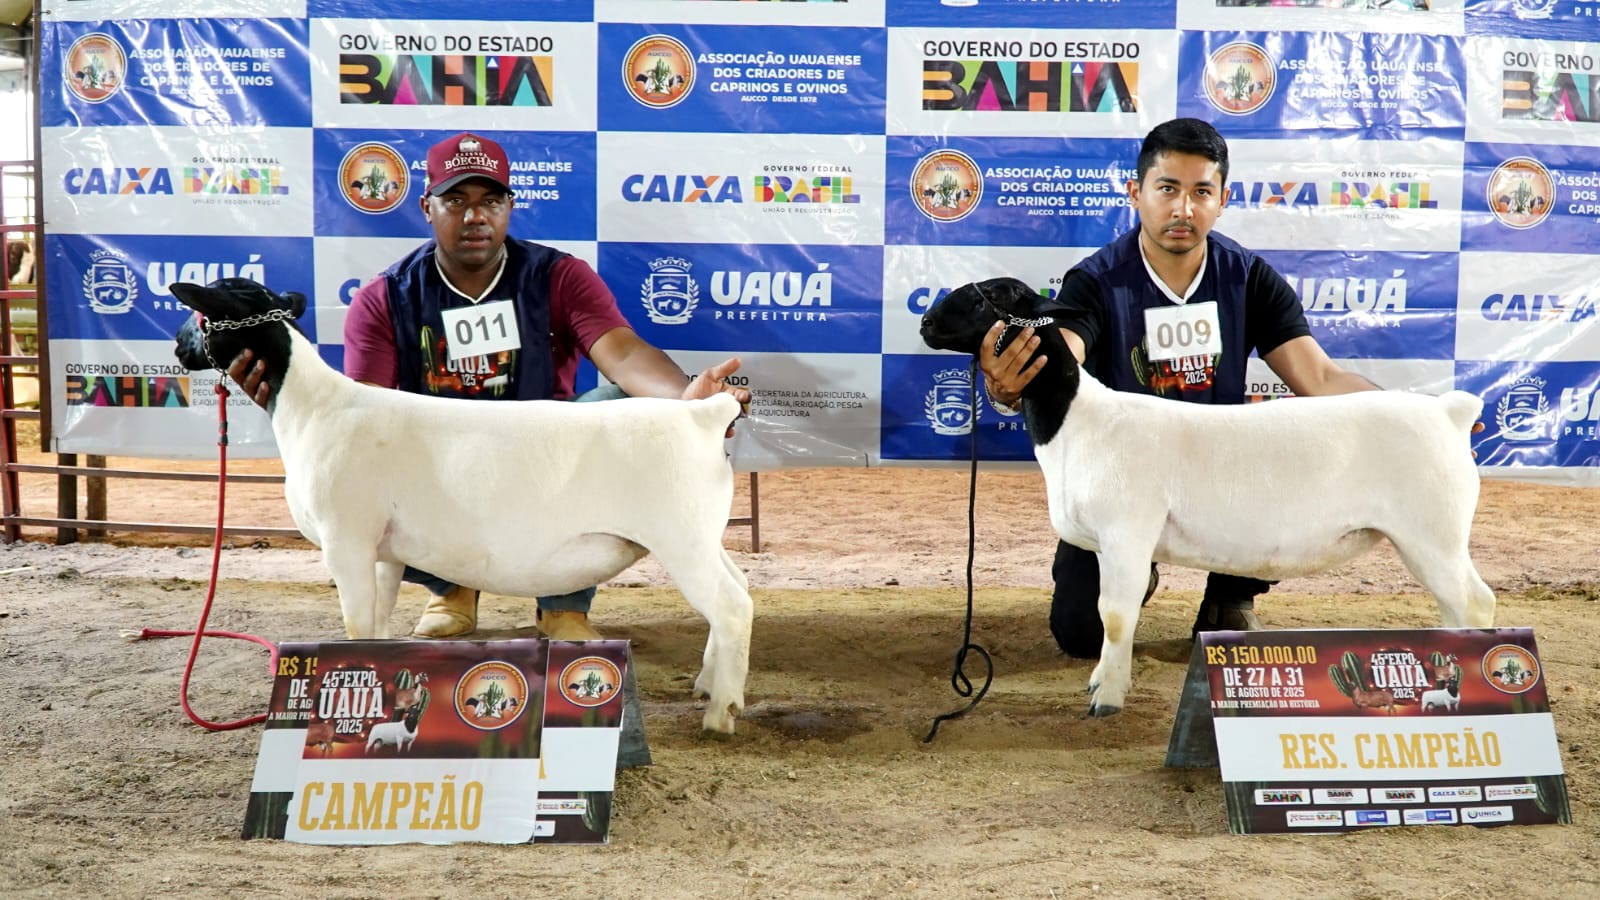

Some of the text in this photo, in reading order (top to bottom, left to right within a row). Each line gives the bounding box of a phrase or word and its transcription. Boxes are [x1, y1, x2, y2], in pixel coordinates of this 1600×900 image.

[339, 34, 553, 52] GOVERNO DO ESTADO
[923, 40, 1140, 59] GOVERNO DO ESTADO
[698, 51, 862, 67] ASSOCIAÇÃO UAUAENSE
[252, 62, 270, 72] DE
[713, 67, 845, 80] DOS CRIADORES DE
[210, 76, 218, 86] E
[339, 54, 553, 106] BAHIA
[922, 60, 1139, 112] BAHIA
[710, 82, 848, 94] CAPRINOS E OVINOS
[741, 95, 768, 103] AUCCO
[444, 156, 499, 170] BOECHAT
[538, 175, 557, 186] DE
[985, 165, 1139, 181] ASSOCIAÇÃO UAUAENS
[63, 168, 174, 195] CAIXA
[622, 174, 743, 204] CAIXA
[1001, 182, 1029, 193] DOS
[1033, 182, 1110, 194] CRIADORES
[511, 189, 559, 200] OVINOS
[754, 176, 861, 204] BRASIL
[1225, 182, 1319, 208] AIXA
[1331, 182, 1438, 209] BRASIL
[1572, 190, 1598, 201] DOS
[997, 196, 1133, 208] CAPRINOS E OVINOS
[710, 263, 832, 307] UAUÁ
[715, 310, 827, 322] PREFEITURA
[455, 313, 508, 346] 011
[1157, 319, 1212, 349] 009
[65, 363, 190, 376] GOVERNO DO ESTADO
[1185, 370, 1207, 385] 2025
[66, 376, 190, 407] BAHIA
[751, 390, 799, 398] SECRETARIA
[814, 391, 869, 400] AGRICULTURA,
[1251, 383, 1269, 393] DO
[837, 401, 863, 409] PESCA
[759, 409, 810, 417] AQUICULTURA
[1205, 645, 1318, 666] R$ 150.000,00
[277, 656, 300, 676] R$
[1223, 667, 1305, 687] DE 27 A 31
[1371, 661, 1429, 689] UAUÁ
[289, 679, 310, 698] DE
[1225, 687, 1305, 698] DE AGOSTO DE 2025
[1393, 688, 1415, 699] 2025
[287, 698, 299, 710] DE
[318, 681, 385, 719] UAUÁ
[1211, 700, 1217, 709] A
[1217, 700, 1239, 709] MAIOR
[1279, 699, 1289, 708] DA
[268, 711, 275, 721] A
[275, 711, 299, 721] MAIOR
[336, 719, 363, 734] 2025
[1279, 727, 1502, 770] RES. CAMPEÃO
[298, 774, 484, 831] CAMPEÃO
